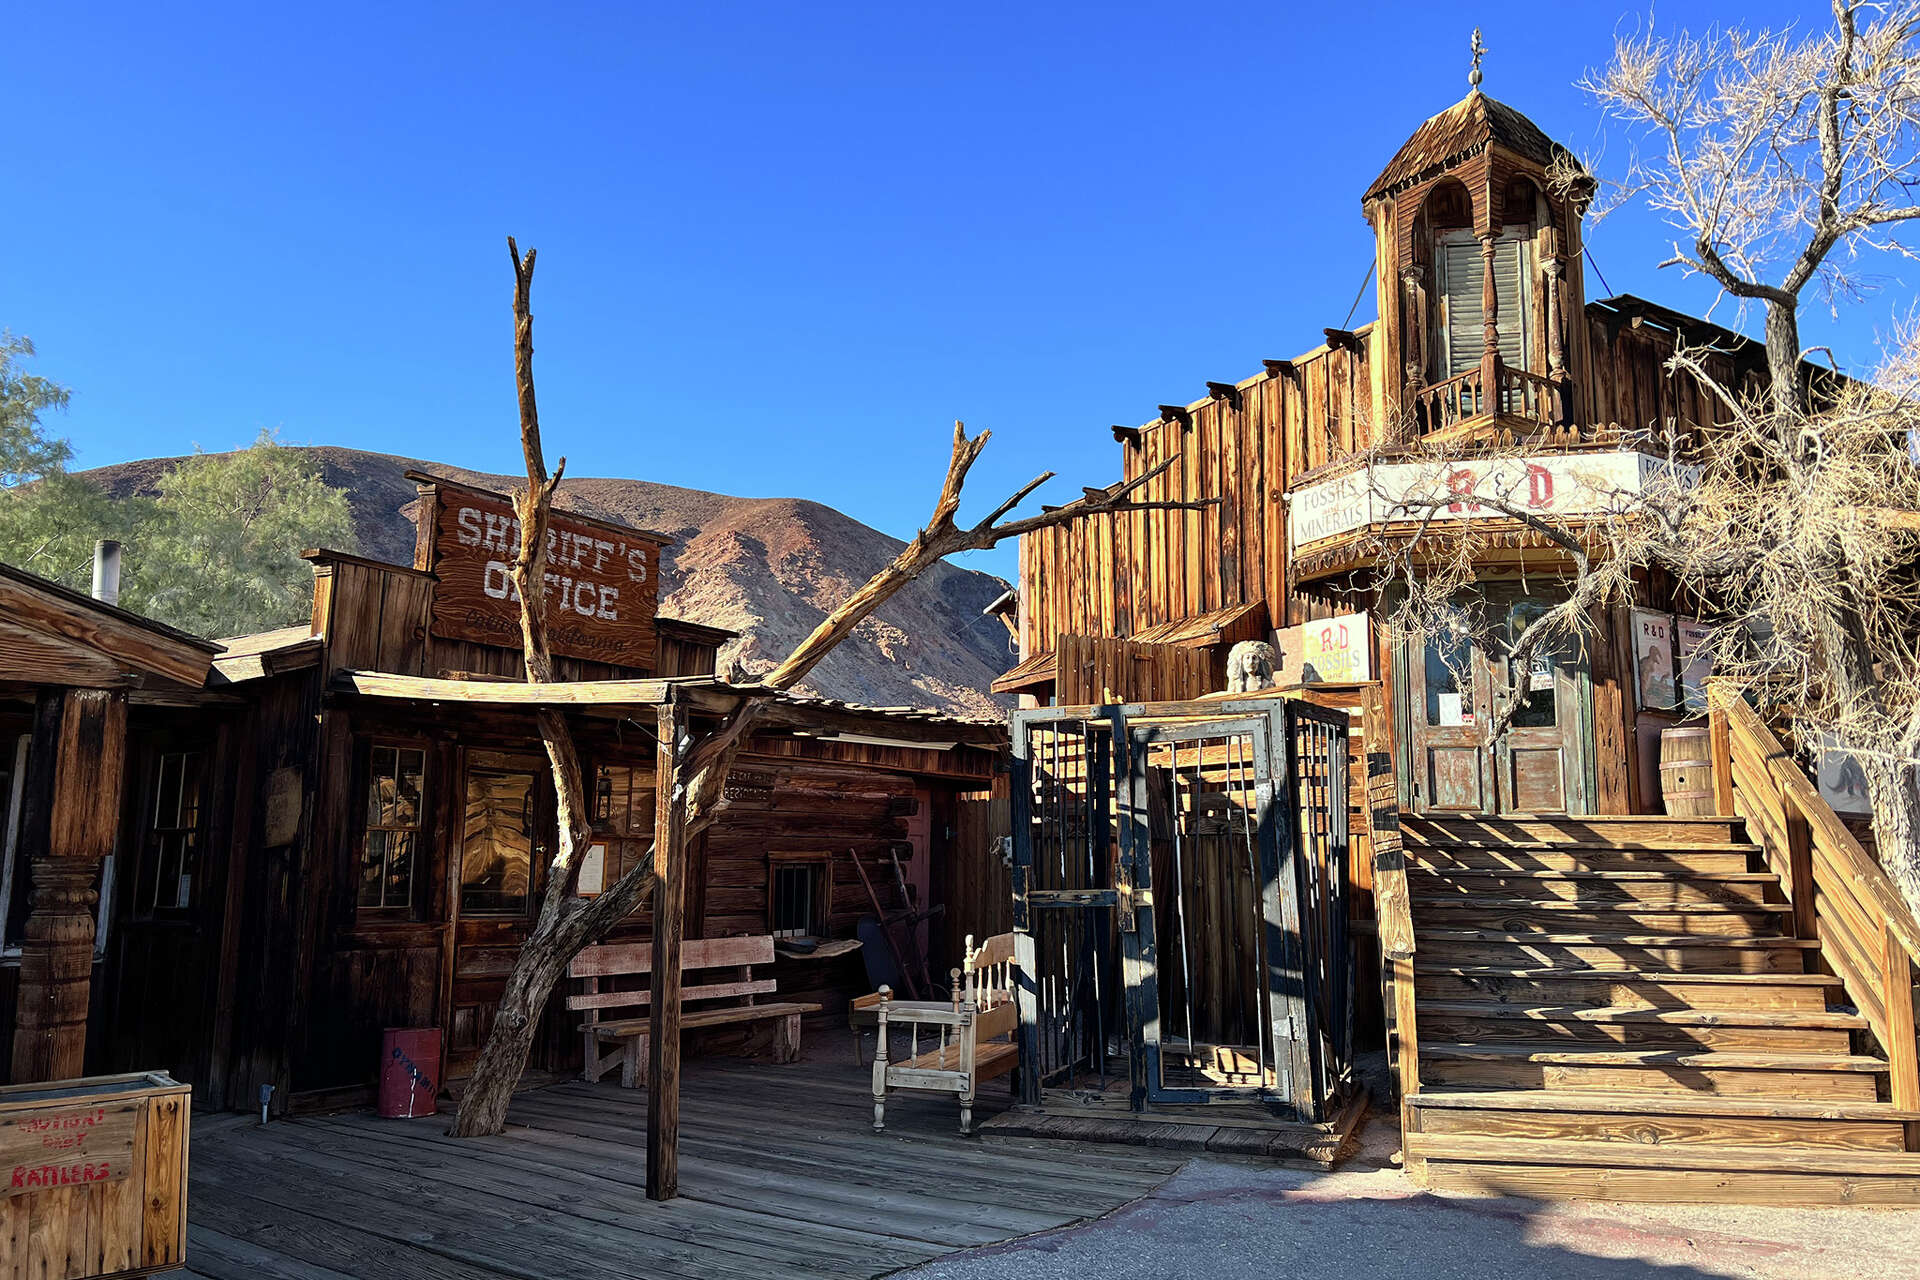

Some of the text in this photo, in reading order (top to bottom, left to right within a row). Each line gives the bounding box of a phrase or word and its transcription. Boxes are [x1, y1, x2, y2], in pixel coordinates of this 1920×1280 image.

[1448, 469, 1481, 513] R
[1528, 463, 1553, 509] D
[1300, 503, 1364, 539] MINERALS
[484, 560, 620, 621] OICE
[1321, 627, 1334, 652] R
[1339, 624, 1349, 649] D
[1643, 623, 1654, 636] R
[1658, 626, 1664, 638] D
[11, 1162, 110, 1188] RATTLERS
